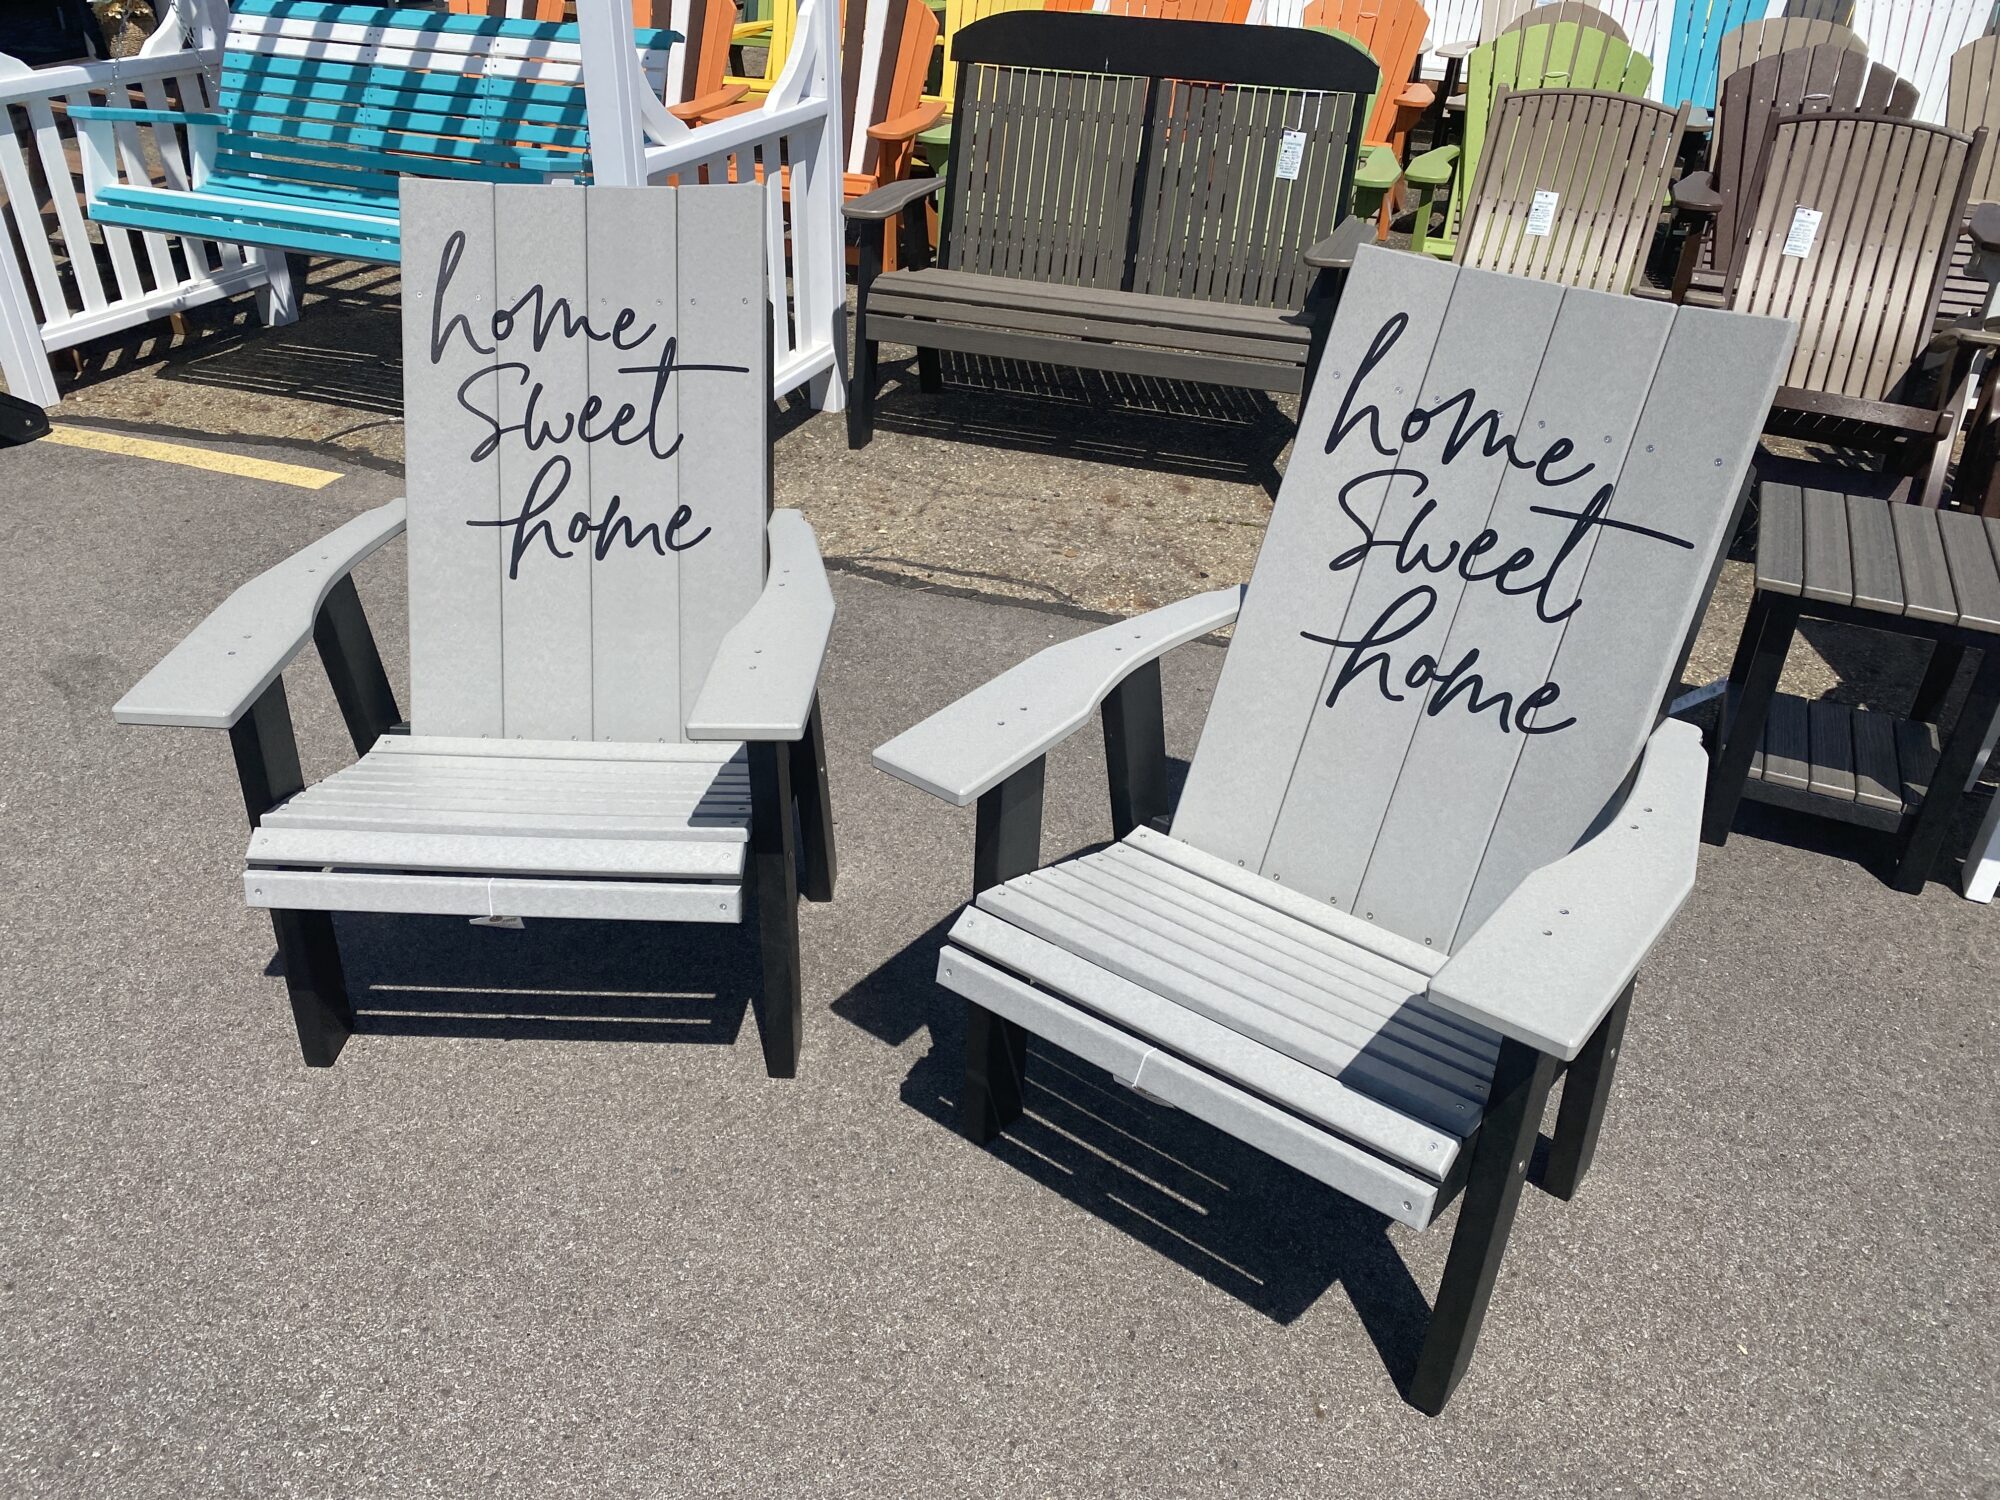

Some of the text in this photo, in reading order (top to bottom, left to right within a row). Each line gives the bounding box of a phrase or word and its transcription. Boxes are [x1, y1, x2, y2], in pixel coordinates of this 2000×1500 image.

[431, 231, 657, 363] home
[1325, 313, 1595, 486] home
[467, 455, 711, 579] home
[1301, 585, 1576, 734] home
